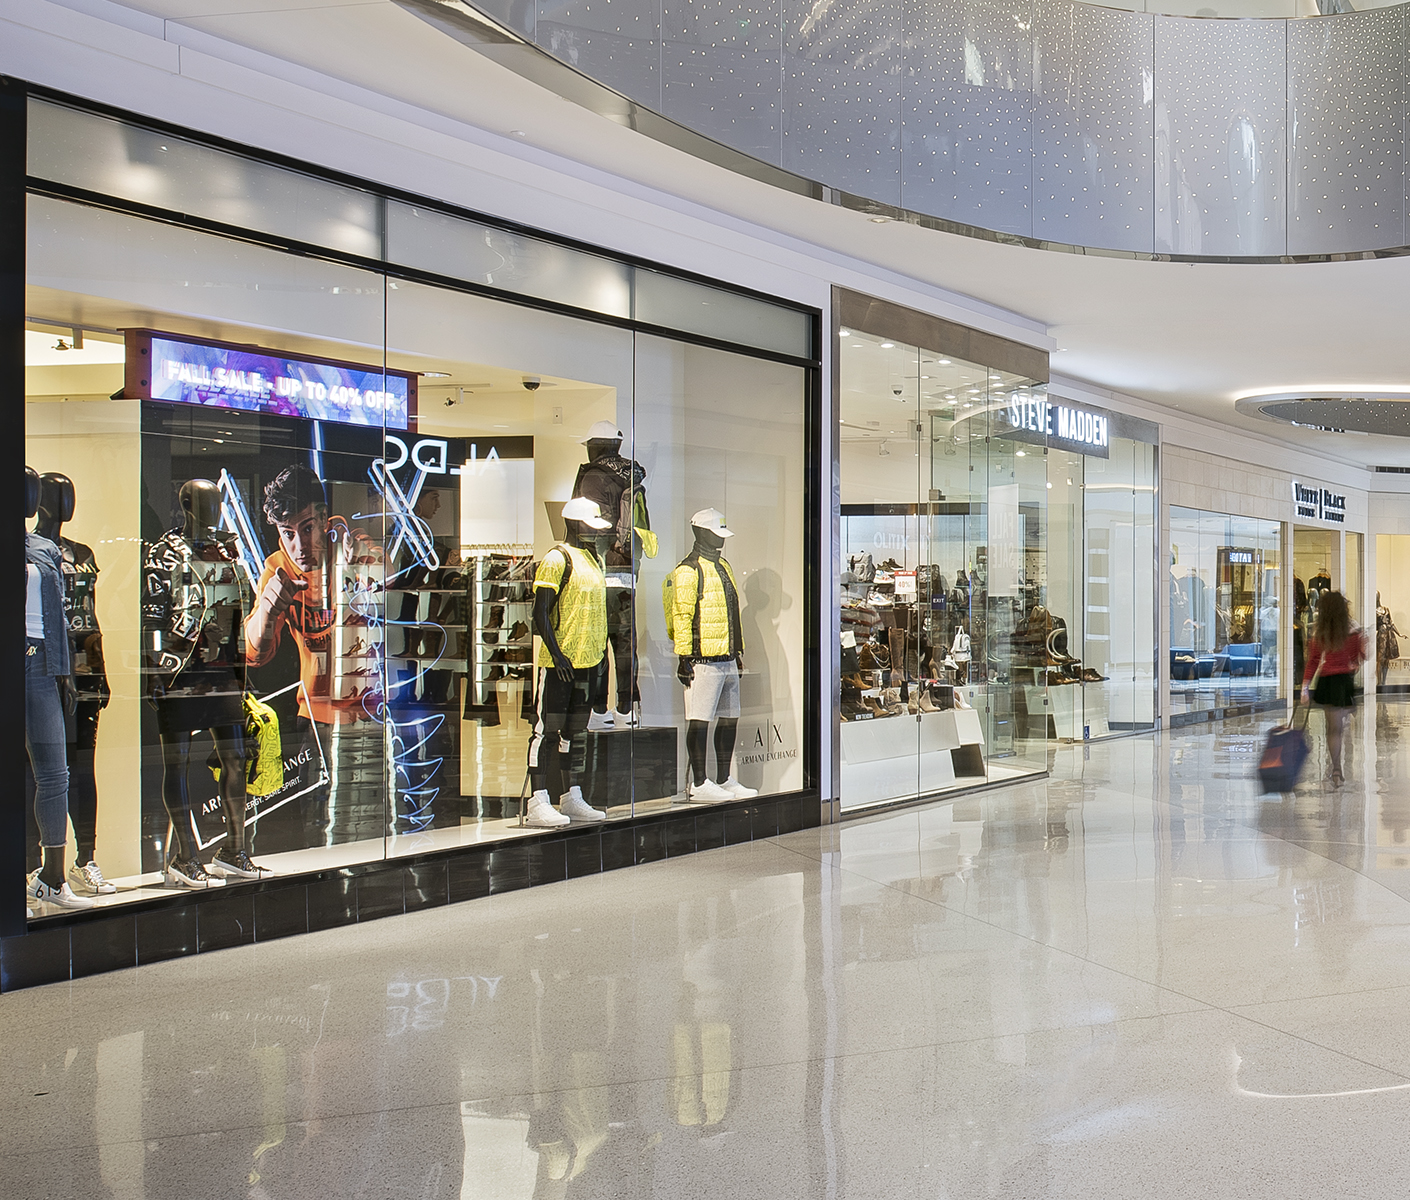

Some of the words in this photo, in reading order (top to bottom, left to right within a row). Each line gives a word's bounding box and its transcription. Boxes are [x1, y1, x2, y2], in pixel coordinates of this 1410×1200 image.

[166, 359, 214, 385] FALL
[213, 367, 263, 394] SALE
[276, 376, 302, 397] UP
[306, 381, 327, 400] TO
[329, 386, 363, 407] 40%
[366, 390, 397, 413] OFF
[1011, 394, 1053, 435] STEVE
[1058, 405, 1108, 447] MADDEN
[1294, 482, 1319, 505] WHITE
[1323, 489, 1346, 510] BLACK
[283, 748, 313, 774] ANGE
[741, 753, 765, 766] ARMANI
[766, 748, 797, 762] EXCHANGE
